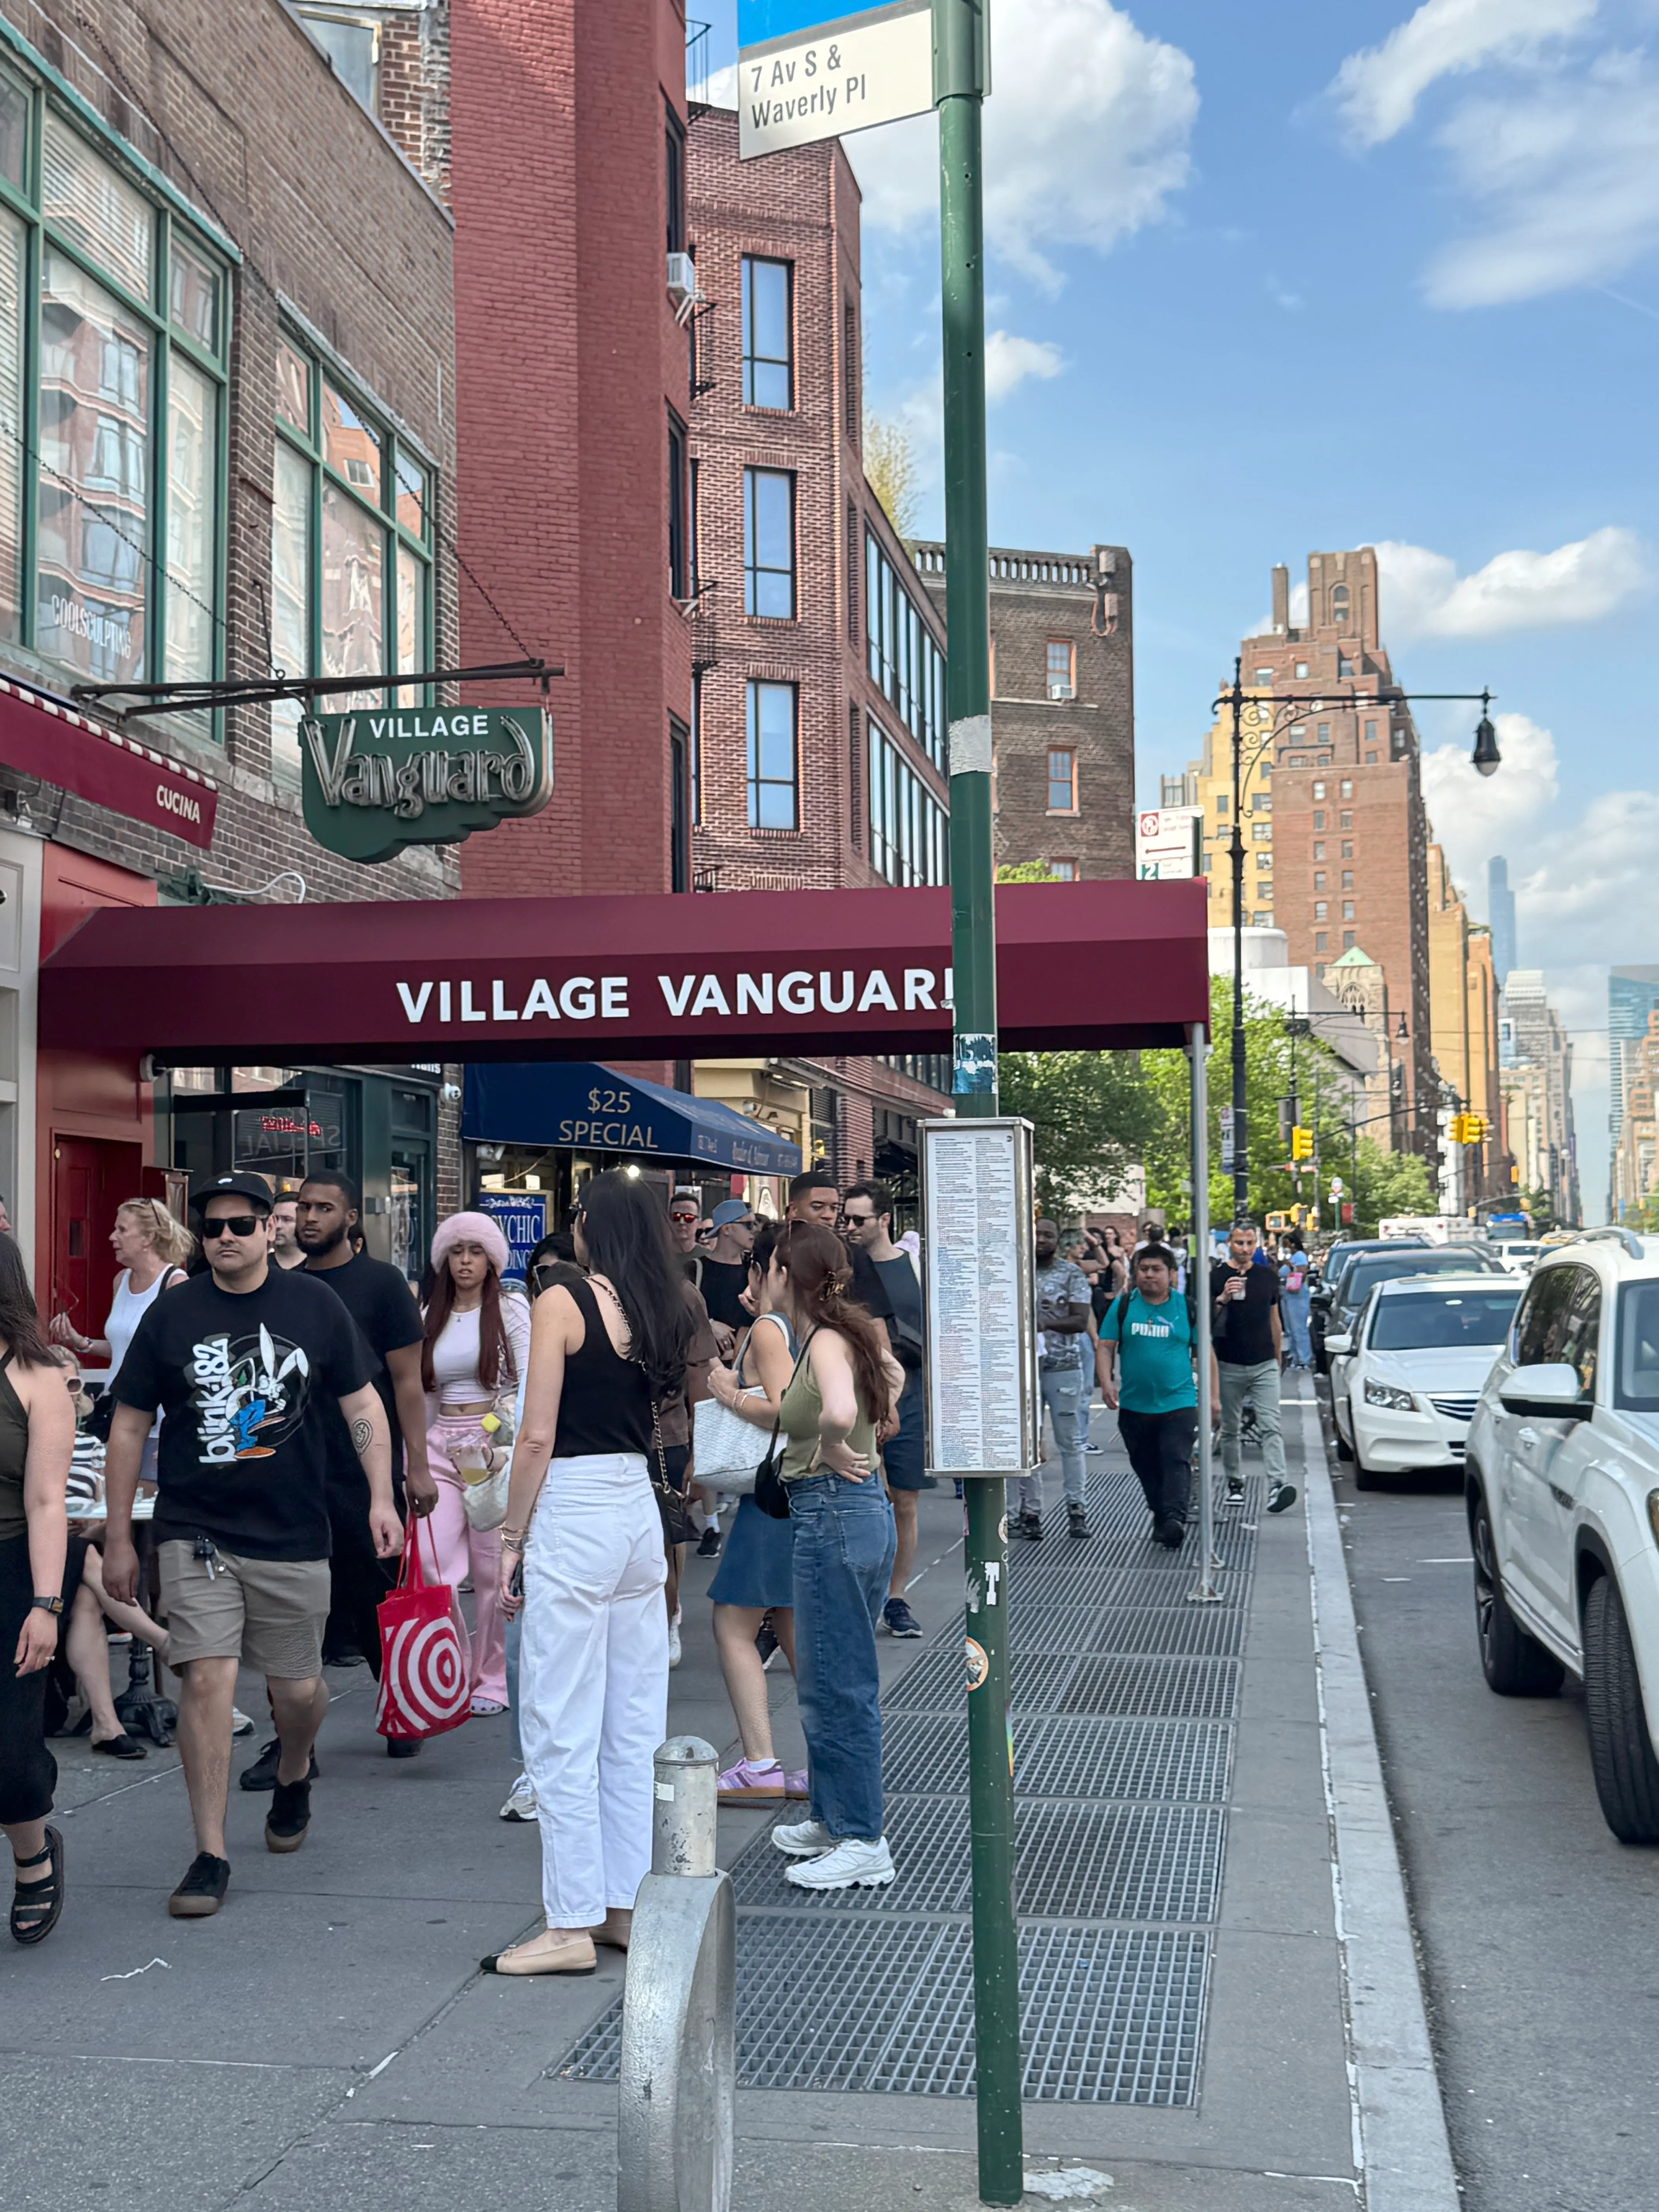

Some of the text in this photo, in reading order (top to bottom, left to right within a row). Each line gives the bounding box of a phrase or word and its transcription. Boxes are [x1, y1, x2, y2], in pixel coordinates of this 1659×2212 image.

[751, 44, 842, 93] 7 Av S &
[752, 74, 866, 129] Waverly Pl
[52, 594, 131, 659] COOLSCULPTING
[369, 715, 489, 738] VILLAGE
[303, 715, 535, 819] Vanguard
[156, 785, 200, 824] CUCINA
[396, 968, 954, 1023] VILLAGE VANGUAR
[587, 1087, 631, 1114] $25
[558, 1120, 658, 1148] SPECIAL
